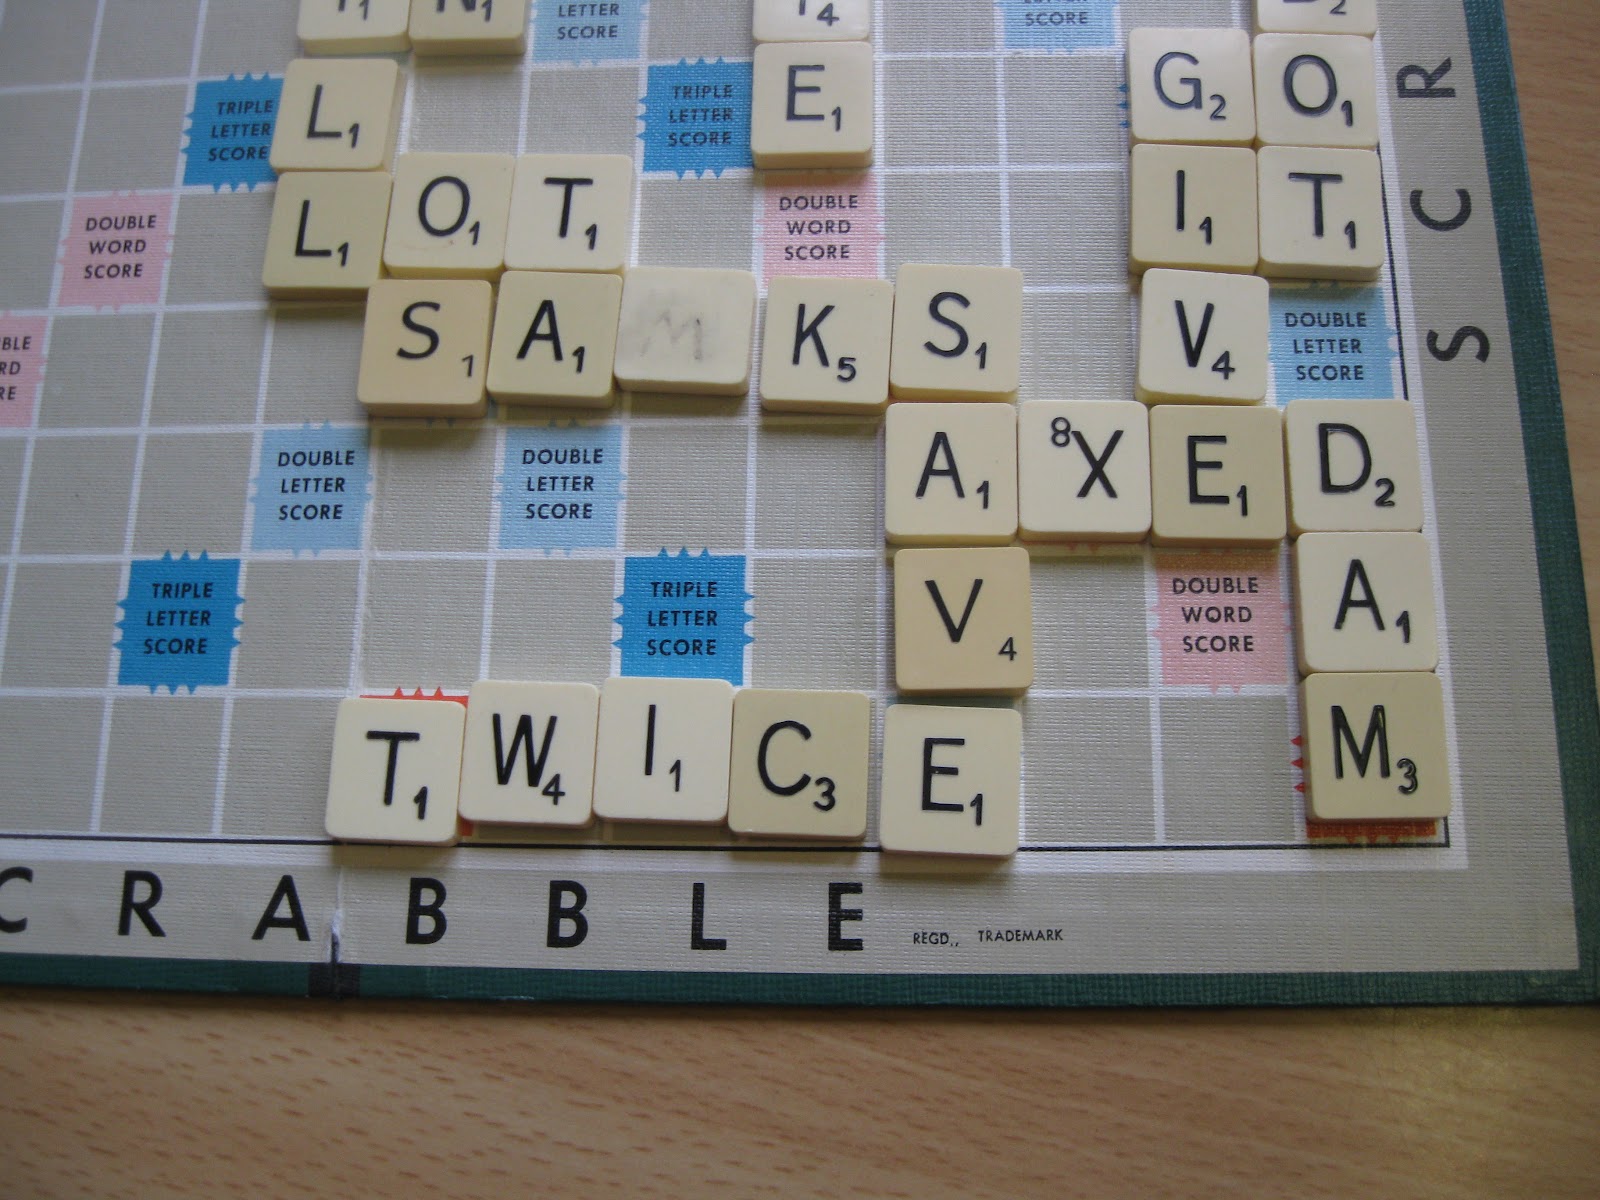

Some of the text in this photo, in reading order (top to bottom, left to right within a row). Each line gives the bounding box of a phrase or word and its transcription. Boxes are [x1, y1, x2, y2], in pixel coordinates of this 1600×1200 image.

[558, 3, 619, 17] LETTER
[1025, 12, 1088, 26] SCORE
[557, 25, 617, 39] SCORE
[672, 85, 733, 98] TRIPLE
[216, 101, 273, 115] TRIPLE
[669, 109, 734, 123] LETTER
[211, 123, 271, 138] LETTER
[668, 132, 731, 147] SCORE
[208, 146, 270, 161] SCORE
[779, 194, 858, 210] DOUBLE
[85, 215, 157, 231] DOUBLE
[787, 219, 851, 235] WORD
[89, 239, 146, 255] WORD
[784, 245, 849, 261] SCORE
[84, 263, 143, 279] SCORE
[1284, 312, 1367, 328] DOUBLE
[1293, 338, 1362, 354] LETTER
[1295, 364, 1364, 381] SCORE
[277, 450, 355, 467] DOUBLE
[522, 448, 604, 465] DOUBLE
[280, 477, 346, 494] LETTER
[526, 475, 595, 493] LETTER
[278, 504, 344, 521] SCORE
[525, 503, 594, 520] SCORE
[152, 582, 214, 599] TRIPLE
[651, 581, 718, 598] TRIPLE
[1172, 577, 1258, 594] DOUBLE
[146, 610, 211, 627] LETTER
[647, 610, 718, 627] LETTER
[1181, 607, 1253, 623] WORD
[143, 638, 208, 655] SCORE
[647, 638, 717, 656] SCORE
[1182, 635, 1255, 653] SCORE
[978, 929, 1063, 942] TRADEMARK
